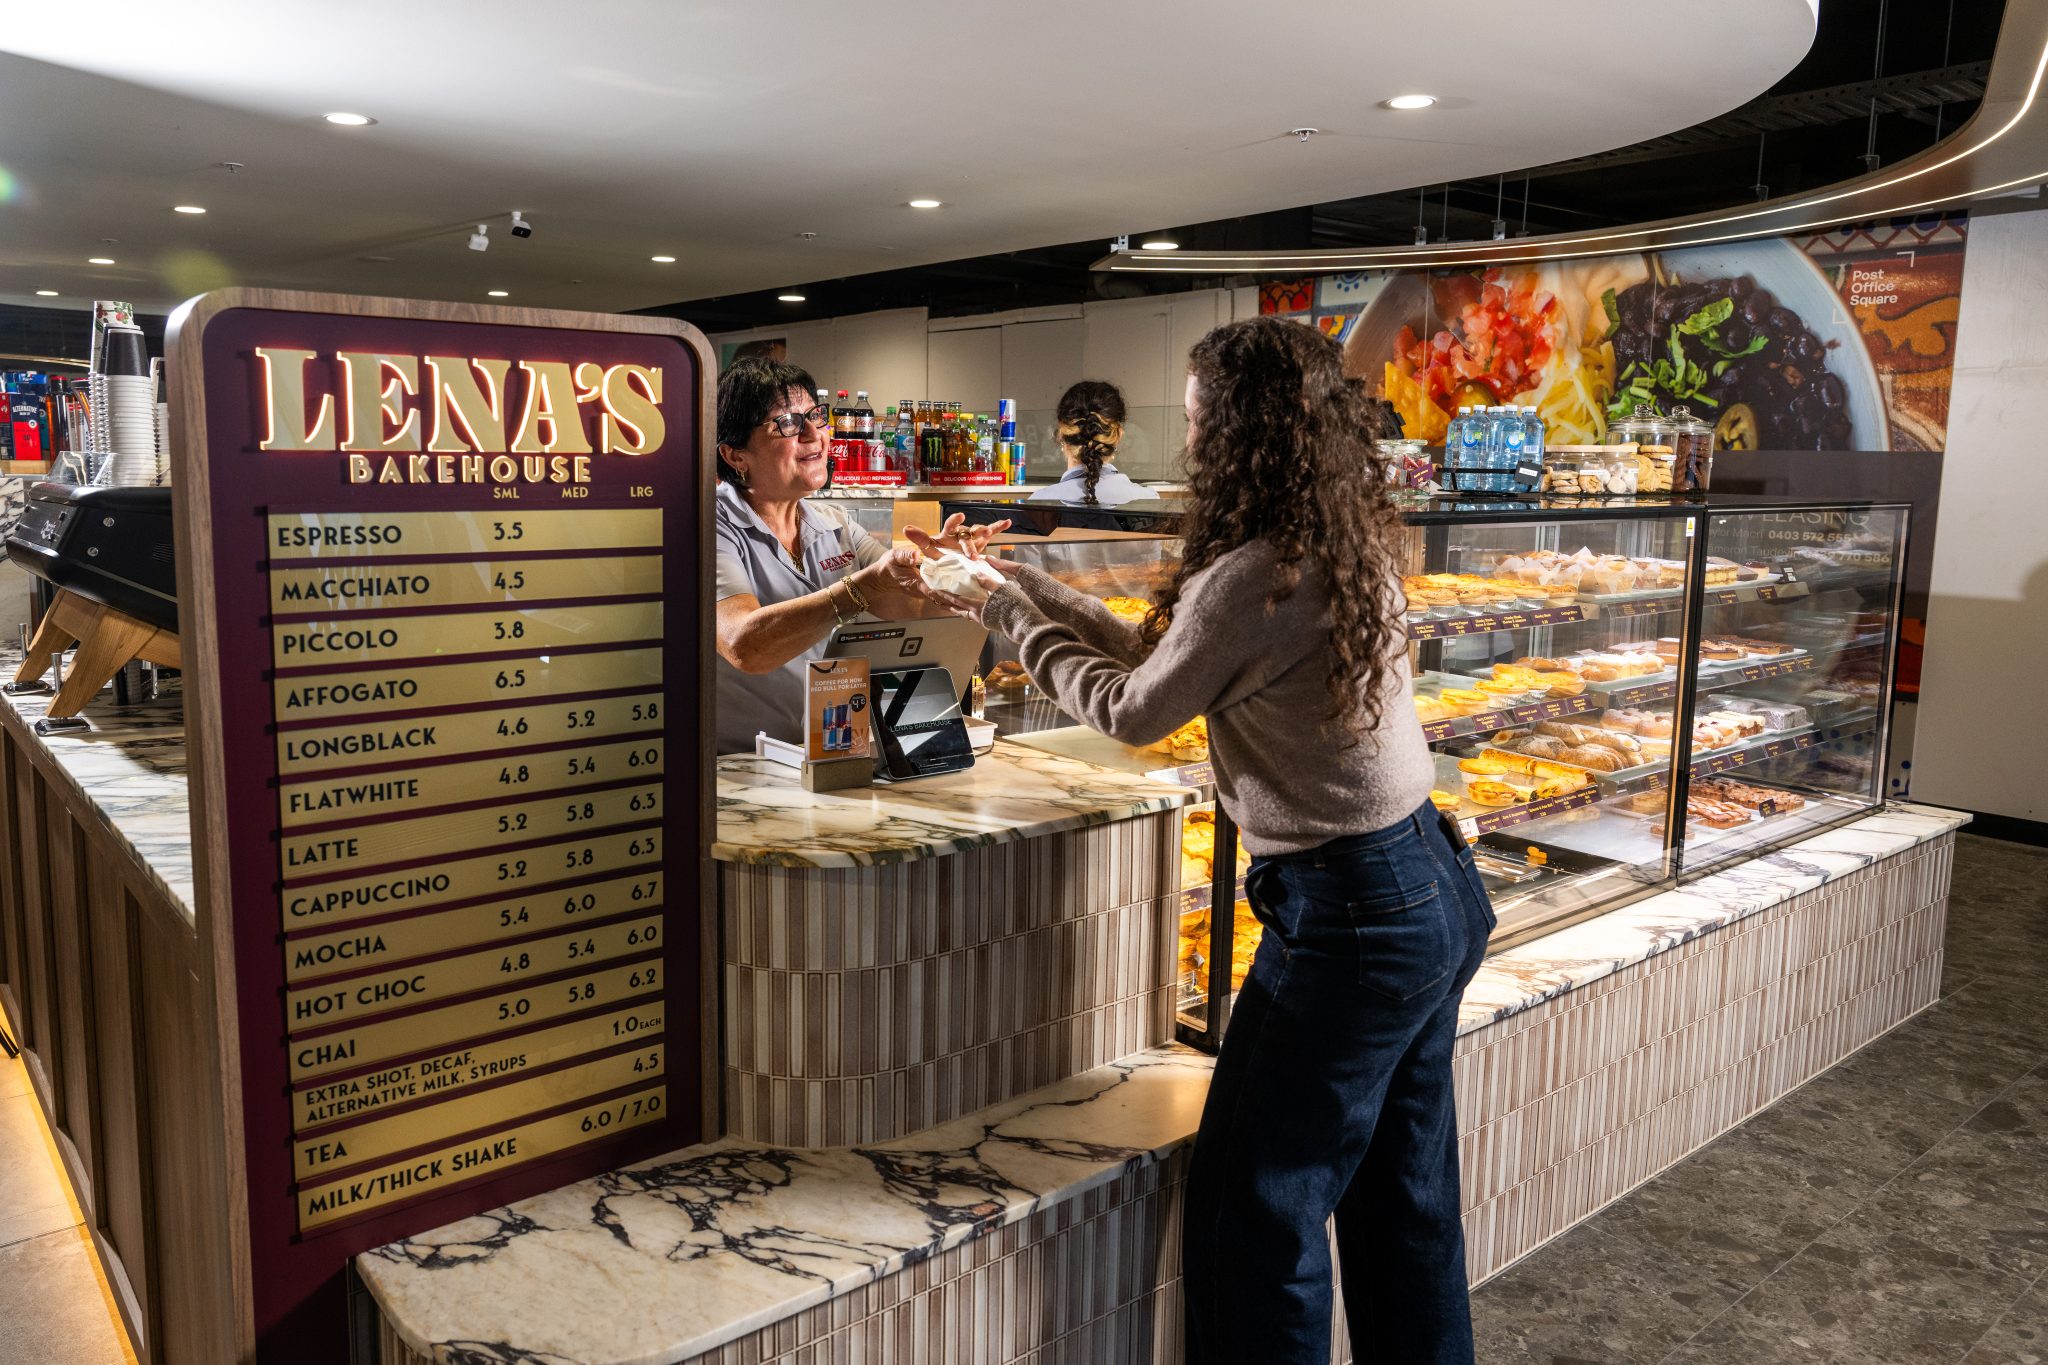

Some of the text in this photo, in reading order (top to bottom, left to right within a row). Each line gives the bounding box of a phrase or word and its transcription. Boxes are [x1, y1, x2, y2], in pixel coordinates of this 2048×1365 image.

[1851, 281, 1895, 294] Office
[1852, 268, 1885, 281] Post
[1849, 294, 1898, 308] Square
[255, 346, 666, 456] LENA'S
[349, 454, 592, 484] BAKEHOUSE
[493, 486, 654, 500] SML MED LRG
[277, 524, 402, 547] ESPRESSO
[493, 521, 524, 541] 3.5
[1768, 530, 1799, 541] 0403
[1802, 531, 1824, 542] 572
[1864, 553, 1889, 563] 586
[280, 575, 430, 602] MACCHIATO
[493, 570, 525, 590] 4.5
[282, 628, 399, 655] PICCOLO
[493, 620, 525, 640] 3.8
[285, 678, 418, 709] AFFOGATO
[495, 669, 526, 689] 6.5
[496, 702, 659, 737] 4.6 5.2 5.8
[914, 720, 953, 730] BAKEHOUSE
[287, 726, 437, 761] LONGBLACK
[498, 748, 659, 785] 4.8 5.4 6.0
[289, 778, 419, 814] FLATWHITE
[497, 792, 656, 834] 5.2 5.8 6.3
[288, 837, 359, 867] LATTE
[497, 837, 656, 881] 5.2 5.8 6.3
[290, 873, 451, 917] CAPPUCCINO
[500, 880, 658, 928] 5.4 6.0 6.7
[294, 935, 387, 969] MOCHA
[499, 925, 658, 973] 4.8 5.4 6.0
[295, 975, 426, 1020] HOT CHOC
[498, 967, 656, 1021] 5.0 5.8 6.2
[612, 1015, 662, 1037] 1.0 EACH
[297, 1039, 356, 1069] CHAI
[633, 1052, 659, 1073] 4.5
[305, 1081, 361, 1106] EXTRA
[306, 1082, 417, 1123] ALTERNATIVE
[469, 1053, 527, 1080] SYRUPS
[580, 1095, 661, 1133] 6.0 / 7.0
[304, 1140, 348, 1166] TEA
[308, 1137, 517, 1218] MILK/THICK SHAKE
